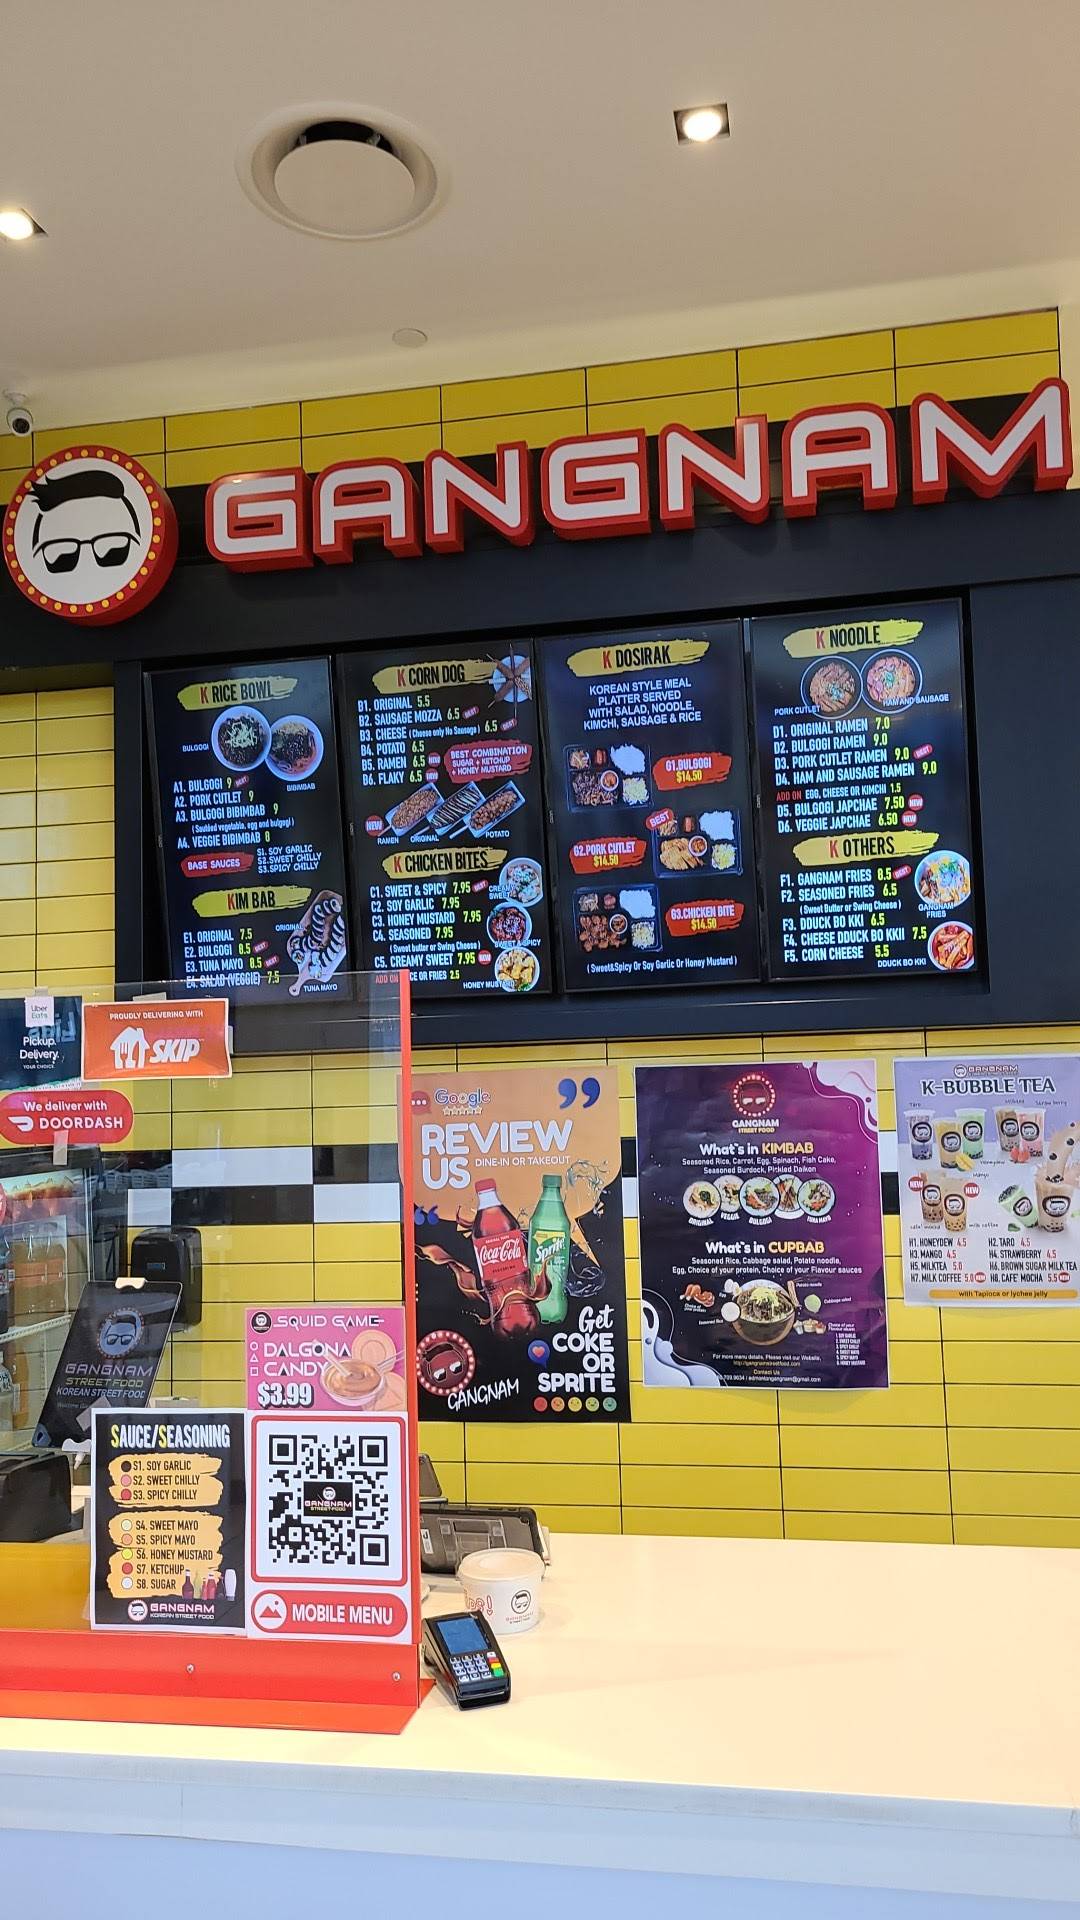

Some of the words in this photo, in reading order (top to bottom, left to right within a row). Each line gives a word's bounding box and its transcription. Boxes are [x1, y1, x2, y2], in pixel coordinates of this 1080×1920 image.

[205, 377, 1074, 573] GANGNAM
[816, 631, 825, 649] K
[830, 626, 881, 647] NOODLE
[602, 651, 612, 669] K
[616, 645, 671, 667] DOSIRAK
[397, 669, 406, 687] K
[409, 666, 439, 685] CORN
[442, 664, 465, 682] DOG
[200, 687, 209, 704] K
[212, 684, 237, 703] RICE
[240, 681, 272, 701] BOWL
[589, 682, 629, 695] KOREAN
[632, 680, 662, 691] STYLE
[664, 678, 691, 689] MEAL
[358, 700, 371, 712] B1.
[374, 697, 412, 710] ORIGINAL
[417, 695, 430, 707] 5.5
[598, 694, 640, 706] PLATTER
[643, 691, 680, 702] SERVED
[359, 715, 372, 727] B2.
[375, 711, 413, 725] SAUSAGE
[415, 709, 442, 722] MOZZA
[447, 708, 460, 719] 6.5
[589, 707, 613, 718] WITH
[615, 704, 649, 716] SALAD,
[652, 701, 694, 713] NOODLE,
[773, 726, 788, 738] D1.
[791, 722, 833, 737] ORIGINAL
[836, 718, 868, 734] RAMEN
[876, 717, 890, 730] 7.0
[362, 759, 375, 771] B5.
[378, 757, 407, 769] RAMEN
[413, 756, 425, 767] 6.5
[775, 757, 789, 770] D3.
[792, 754, 817, 768] PORK
[820, 751, 851, 766] CUTLET
[855, 749, 887, 764] RAMEN
[895, 748, 909, 761] 9.0
[175, 810, 188, 822] A3.
[191, 807, 225, 821] BULGOGI
[227, 805, 265, 818] BIBIMBAB
[273, 804, 278, 814] 9
[650, 811, 670, 827] BEST
[829, 840, 839, 858] K
[843, 836, 894, 857] OTHERS
[393, 856, 402, 873] K
[405, 853, 453, 872] CHICKEN
[455, 851, 488, 869] BITES
[780, 874, 794, 886] F1.
[798, 871, 843, 886] GANGNAM
[845, 869, 872, 882] FRIES
[877, 868, 892, 880] 8.5
[370, 887, 383, 898] C1.
[385, 884, 413, 896] SWEET
[415, 884, 421, 895] &
[423, 883, 447, 895] SPICY
[452, 882, 471, 894] 7.95
[781, 890, 795, 902] F2.
[799, 886, 845, 901] SEASONED
[849, 885, 874, 898] FRIES
[883, 884, 897, 896] 6.5
[227, 892, 248, 910] KIM
[252, 891, 275, 908] BAB
[371, 901, 384, 912] C2.
[387, 900, 403, 912] SOY
[405, 898, 434, 910] GARLIC
[442, 897, 459, 909] 7.95
[183, 932, 196, 943] E1.
[198, 929, 234, 942] ORIGINAL
[240, 929, 252, 940] 7.5
[784, 950, 798, 962] F5.
[802, 948, 826, 962] CORN
[830, 946, 864, 960] CHEESE
[875, 945, 889, 957] 5.5
[109, 1012, 141, 1020] PROUDLY
[143, 1011, 184, 1019] DELIVERING
[186, 1010, 204, 1018] WITH
[23, 1036, 56, 1047] Pickup.
[20, 1049, 59, 1059] Delivery.
[150, 1039, 200, 1064] SKIP
[922, 1079, 1014, 1095] K-BUBBLE
[1019, 1078, 1055, 1093] TEA
[23, 1101, 43, 1112] We
[45, 1101, 82, 1112] deliver
[84, 1101, 107, 1111] with
[435, 1088, 491, 1108] Google
[39, 1117, 123, 1129] DOORDASH
[732, 1119, 779, 1128] GANGNAM
[421, 1119, 573, 1156] REVIEW
[747, 1143, 759, 1154] in
[761, 1142, 814, 1154] KIMBAB
[682, 1158, 713, 1166] Seasoned
[802, 1156, 816, 1164] Fish
[422, 1156, 471, 1190] US
[475, 1157, 510, 1168] DINE-IN
[513, 1157, 525, 1166] OR
[528, 1156, 570, 1165] TAKEOUT
[964, 1185, 979, 1194] NEW
[753, 1241, 765, 1253] in
[768, 1241, 824, 1253] CUPBAB
[988, 1238, 998, 1247] H2.
[1000, 1238, 1015, 1246] TARO
[1021, 1238, 1030, 1246] 4.5
[989, 1250, 999, 1258] H4.
[1000, 1250, 1041, 1258] STRAWBERRY
[1047, 1250, 1056, 1258] 4.5
[1010, 1290, 1033, 1298] lychee
[1034, 1290, 1048, 1298] jelly
[273, 1316, 327, 1331] SQUID
[332, 1316, 384, 1332] GAME
[579, 1304, 615, 1333] Get
[264, 1342, 351, 1357] DALGONA
[552, 1333, 614, 1352] COKE
[65, 1364, 153, 1376] GANGNAM
[264, 1362, 329, 1376] CANDY
[582, 1353, 615, 1372] OR
[65, 1377, 112, 1386] STREET
[112, 1379, 143, 1387] FOOD
[538, 1373, 615, 1393] SPRITE
[56, 1387, 91, 1396] KOREAN
[91, 1388, 122, 1397] STREET
[258, 1381, 313, 1408] $3.99
[447, 1378, 520, 1412] GANGNAM
[111, 1424, 230, 1448] SAUCE/SEASONING
[133, 1462, 145, 1471] S1.
[146, 1462, 161, 1471] SOY
[163, 1461, 191, 1470] GARLIC
[133, 1477, 145, 1486] S2.
[147, 1476, 173, 1485] SWEET
[175, 1475, 200, 1485] CHILLY
[136, 1550, 148, 1559] S6.
[151, 1550, 176, 1560] HONEY
[178, 1550, 213, 1560] MUSTARD
[150, 1603, 215, 1613] GANGNAM
[292, 1604, 345, 1624] MOBILE
[349, 1605, 393, 1625] MENU
